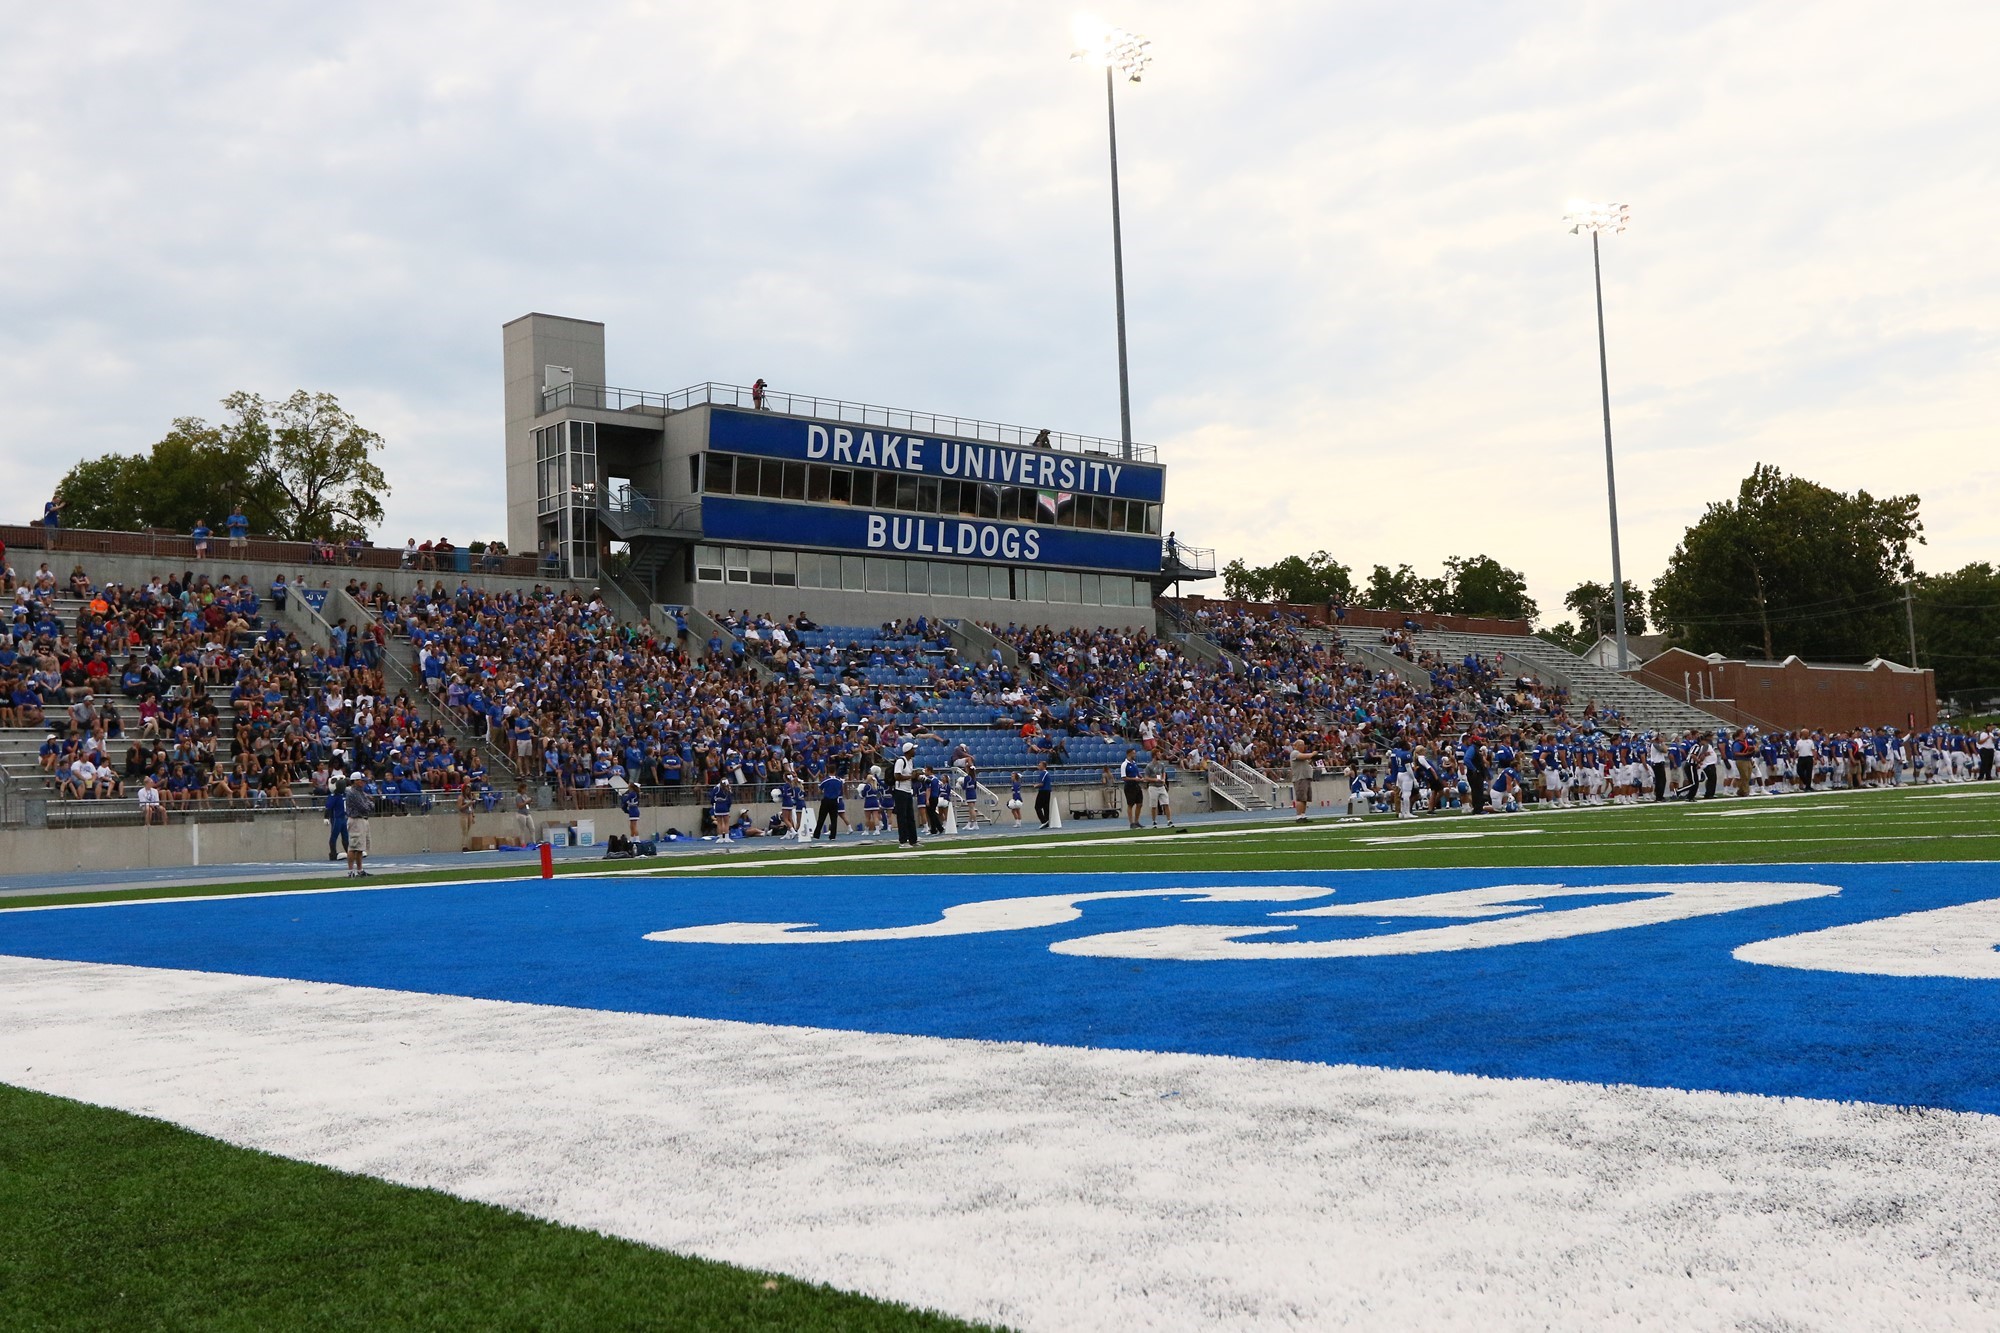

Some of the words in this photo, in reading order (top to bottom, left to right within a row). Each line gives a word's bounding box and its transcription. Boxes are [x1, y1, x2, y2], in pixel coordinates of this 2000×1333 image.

[807, 424, 925, 471] DRAKE
[940, 442, 1122, 494] UNIVERSITY
[867, 514, 1040, 560] BULLDOGS
